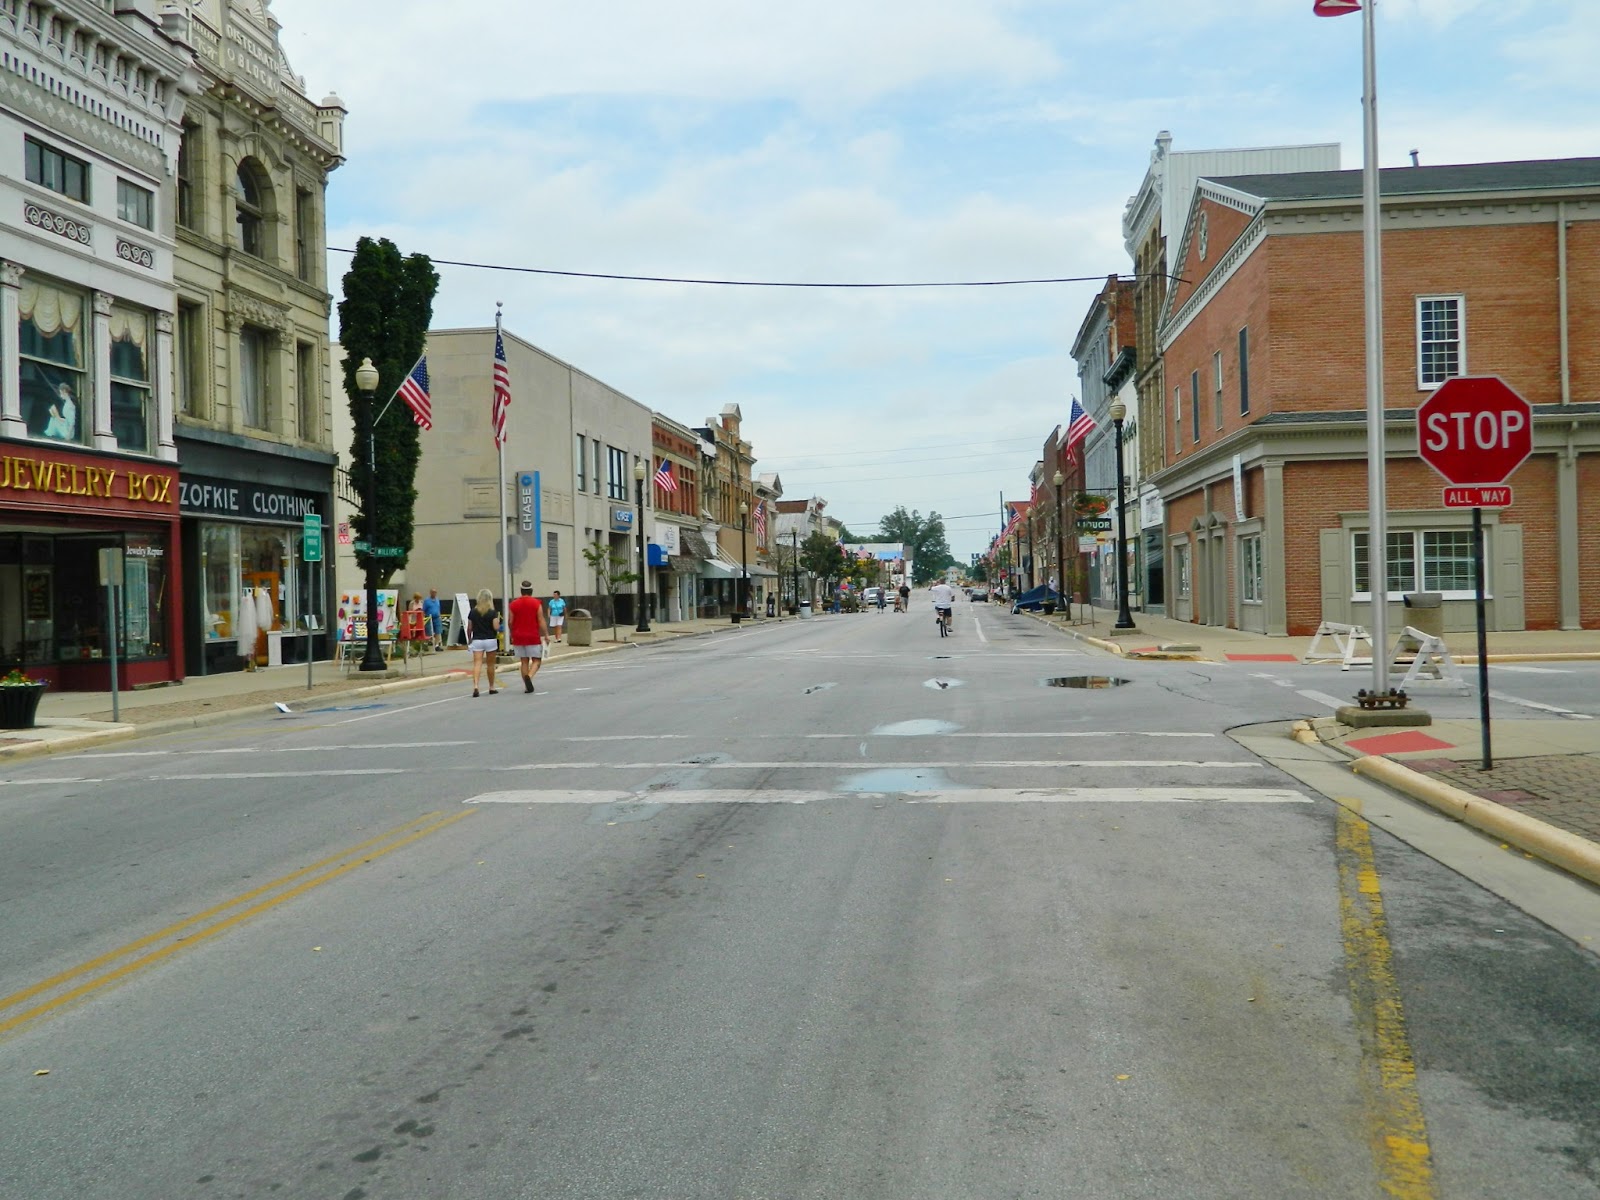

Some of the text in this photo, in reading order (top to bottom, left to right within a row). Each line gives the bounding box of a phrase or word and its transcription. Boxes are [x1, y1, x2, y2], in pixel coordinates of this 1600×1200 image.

[226, 24, 280, 75] DISTELRATH
[238, 53, 273, 91] BLOCK
[1426, 410, 1524, 451] STOP
[1, 456, 172, 503] JEWELRY BOX
[1449, 490, 1506, 503] ALL WAY
[179, 482, 315, 516] ZOFKIE CLOTHING
[523, 488, 532, 531] CHASE
[616, 511, 630, 522] CHASE
[126, 546, 164, 557] Jewelry Repair
